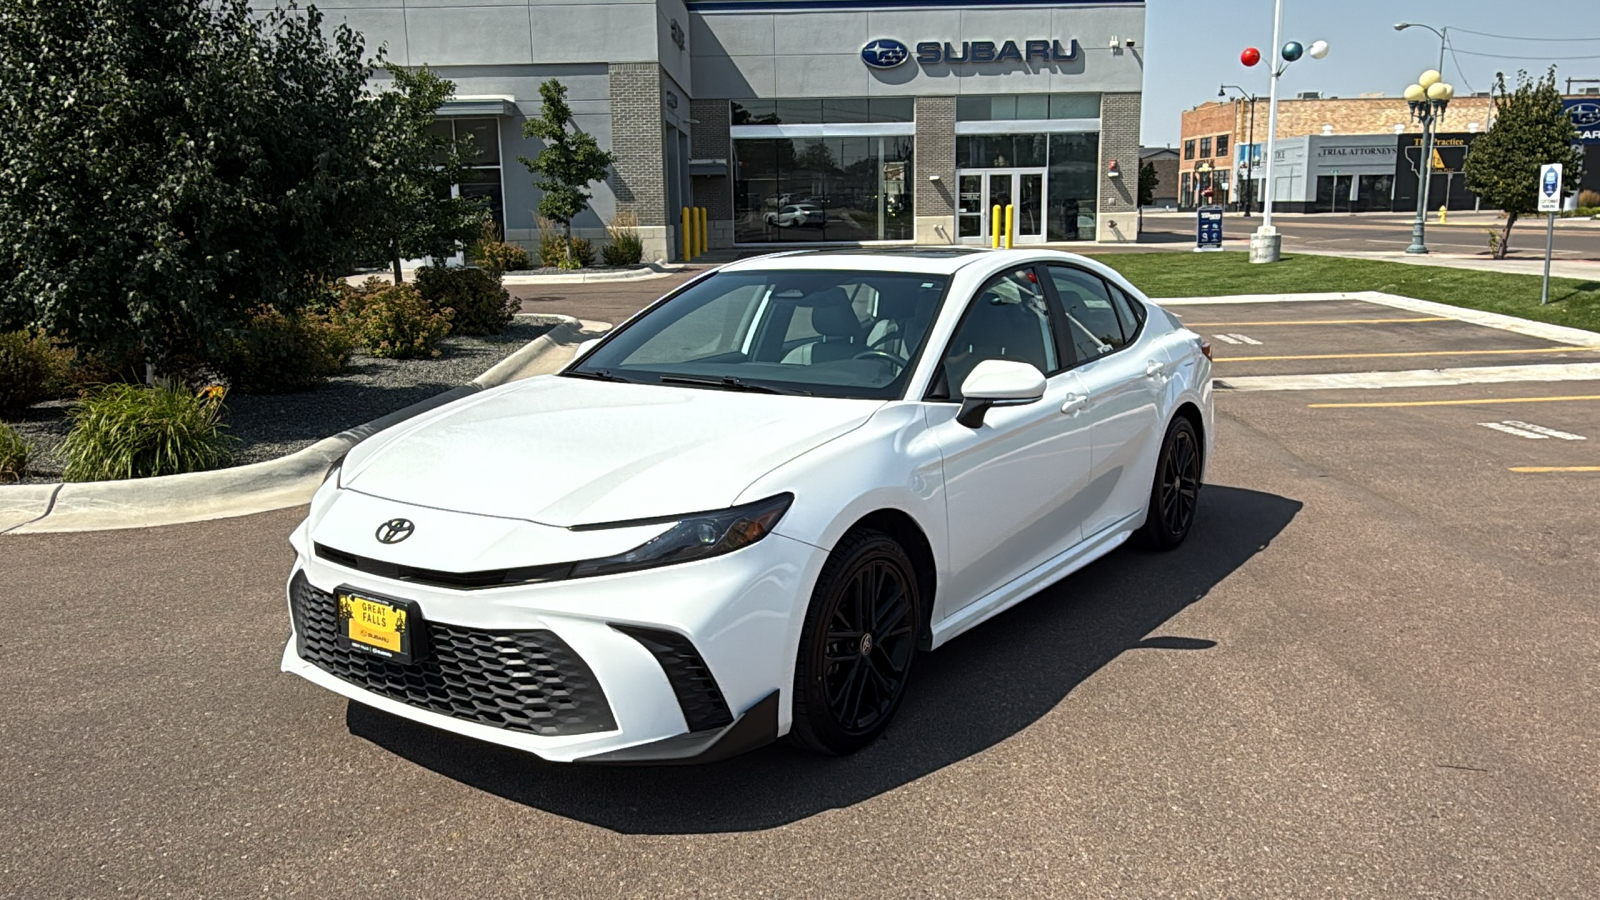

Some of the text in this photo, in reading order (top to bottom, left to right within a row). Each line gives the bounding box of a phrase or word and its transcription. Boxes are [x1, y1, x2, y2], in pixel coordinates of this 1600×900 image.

[916, 39, 1078, 64] SUBARU
[1322, 147, 1397, 156] TRIAL ATTORNEYS
[362, 602, 386, 616] GREAT
[362, 612, 386, 627] FALLS
[367, 633, 389, 643] SUBARU
